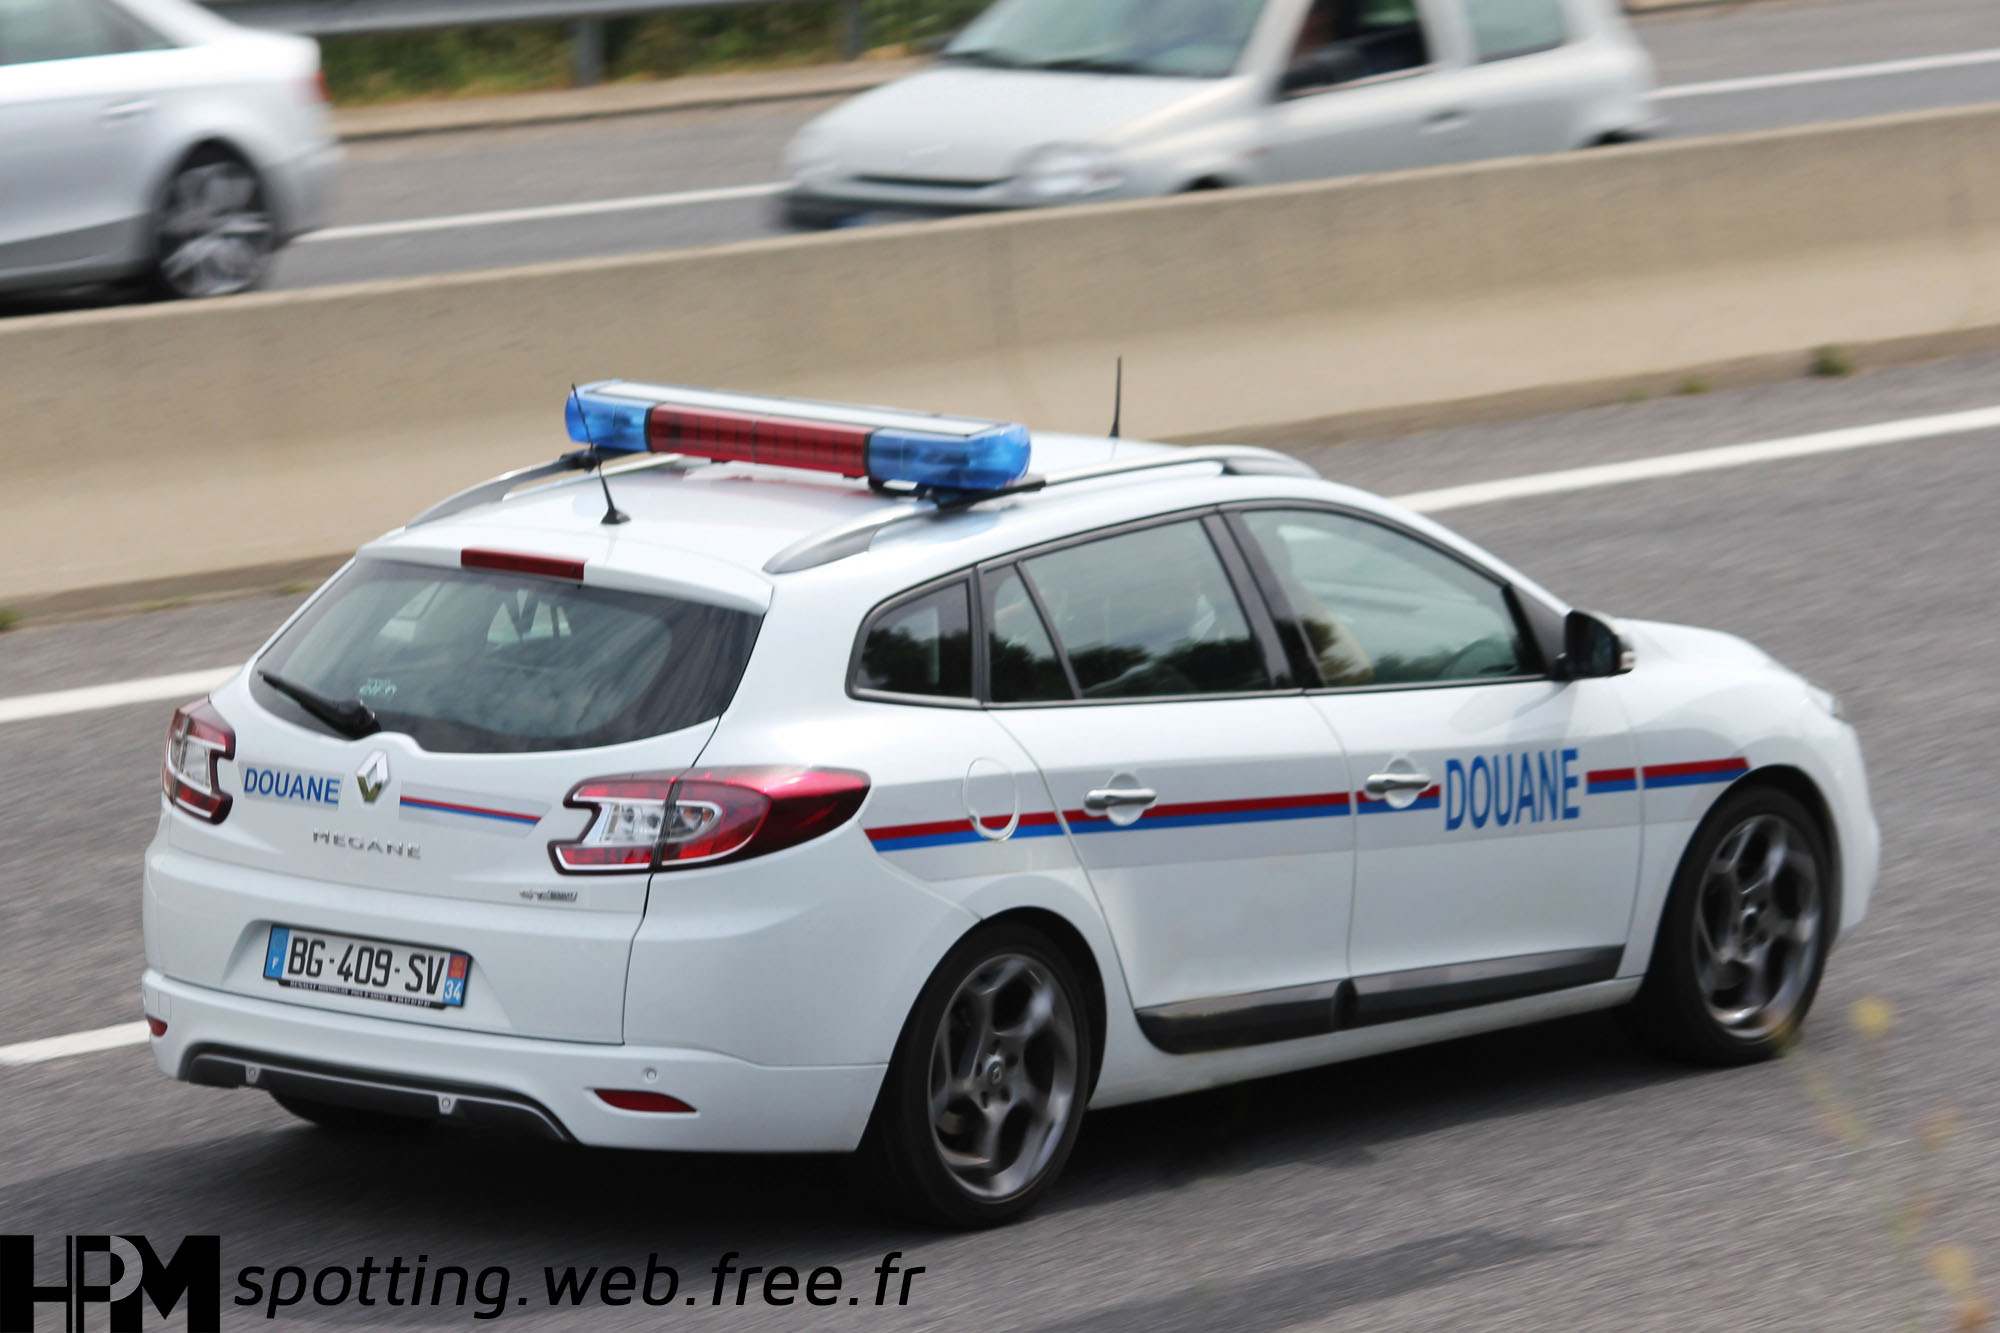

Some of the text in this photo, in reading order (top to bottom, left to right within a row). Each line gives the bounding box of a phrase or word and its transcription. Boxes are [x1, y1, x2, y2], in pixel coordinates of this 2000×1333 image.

[244, 767, 341, 805] DOUANE
[1445, 748, 1579, 831] DOUANE
[312, 830, 422, 860] MEGANE
[443, 980, 462, 1001] 34
